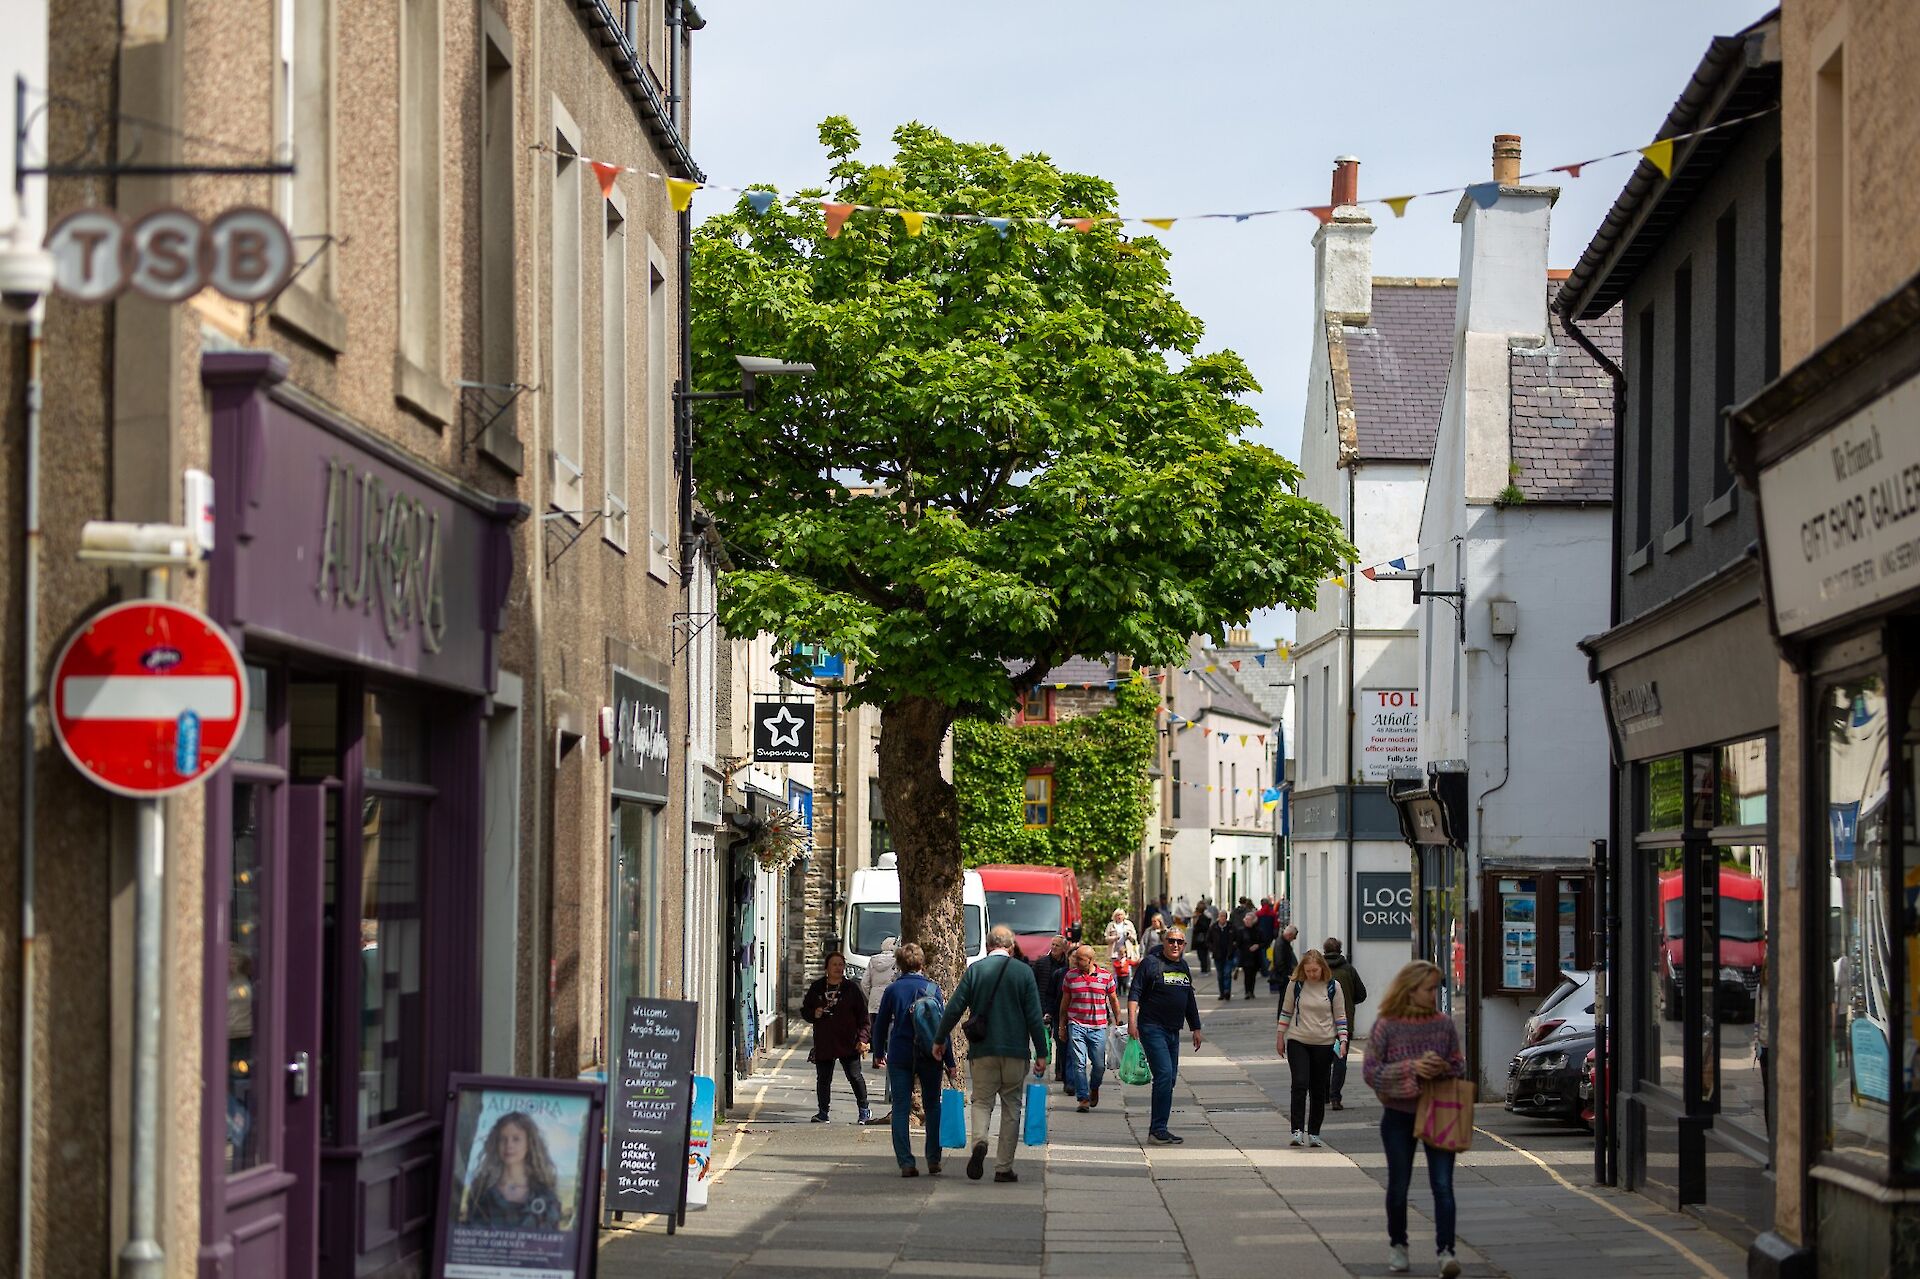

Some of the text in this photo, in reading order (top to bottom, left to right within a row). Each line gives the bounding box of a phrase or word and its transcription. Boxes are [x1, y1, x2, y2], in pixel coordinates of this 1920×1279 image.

[69, 227, 272, 285] TSB
[1801, 511, 1830, 563] GIFT
[316, 455, 446, 654] AURORA
[1378, 692, 1403, 707] TO
[1371, 712, 1413, 726] Atholl
[756, 748, 810, 759] Superdrug
[1387, 755, 1403, 763] Fully
[1363, 888, 1412, 907] LOG
[632, 1005, 668, 1019] Welcome
[646, 1018, 655, 1026] to
[655, 1024, 680, 1043] Bakery
[625, 1078, 677, 1087] CARROT SOUP
[487, 1096, 564, 1117] AURORA
[626, 1100, 677, 1110] MEAT FEAST
[632, 1109, 667, 1119] FRIDAY!
[621, 1140, 650, 1151] LOCAL
[621, 1150, 656, 1161] ORKNEY
[620, 1159, 657, 1171] PRODUCE
